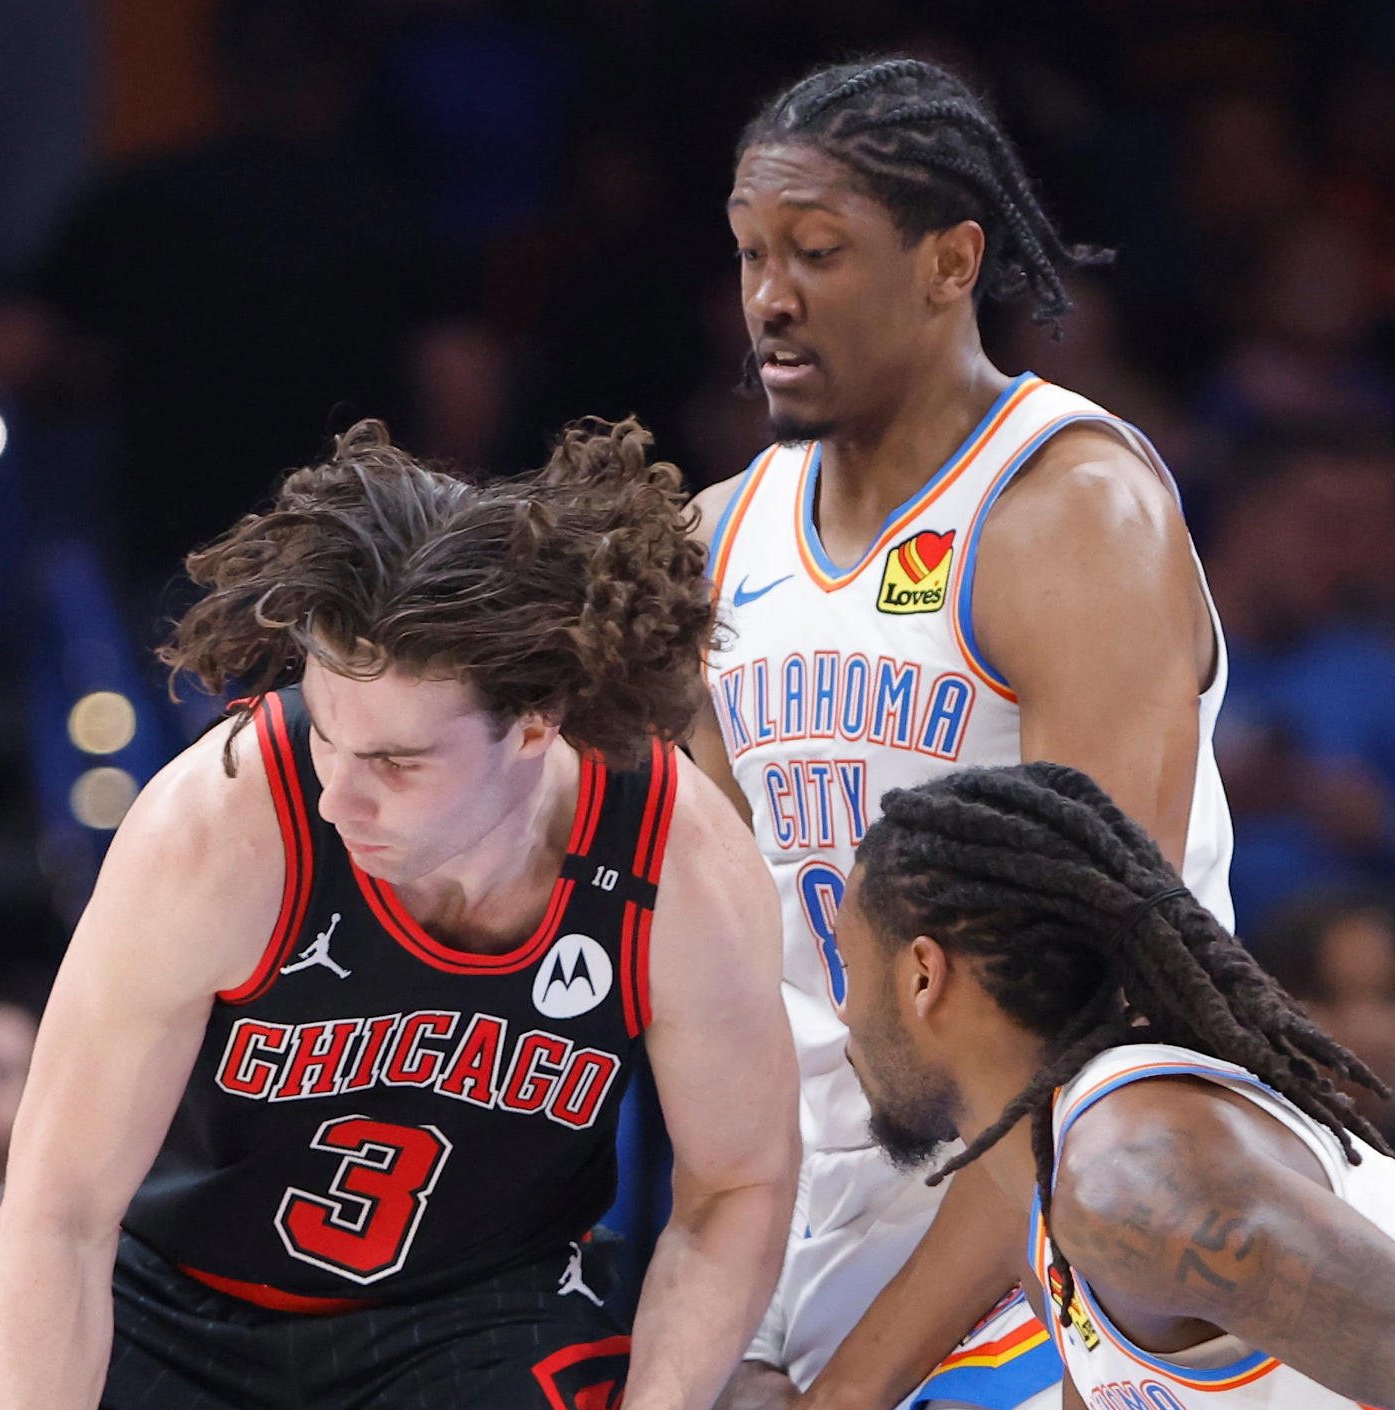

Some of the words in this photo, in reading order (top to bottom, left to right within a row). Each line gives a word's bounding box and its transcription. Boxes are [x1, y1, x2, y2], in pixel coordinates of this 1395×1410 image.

[883, 580, 943, 606] Love's
[712, 650, 976, 761] KLAHOMA
[763, 759, 867, 850] CITY
[591, 865, 619, 891] 10
[215, 1010, 621, 1130] CHICAGO
[274, 1114, 453, 1285] 3
